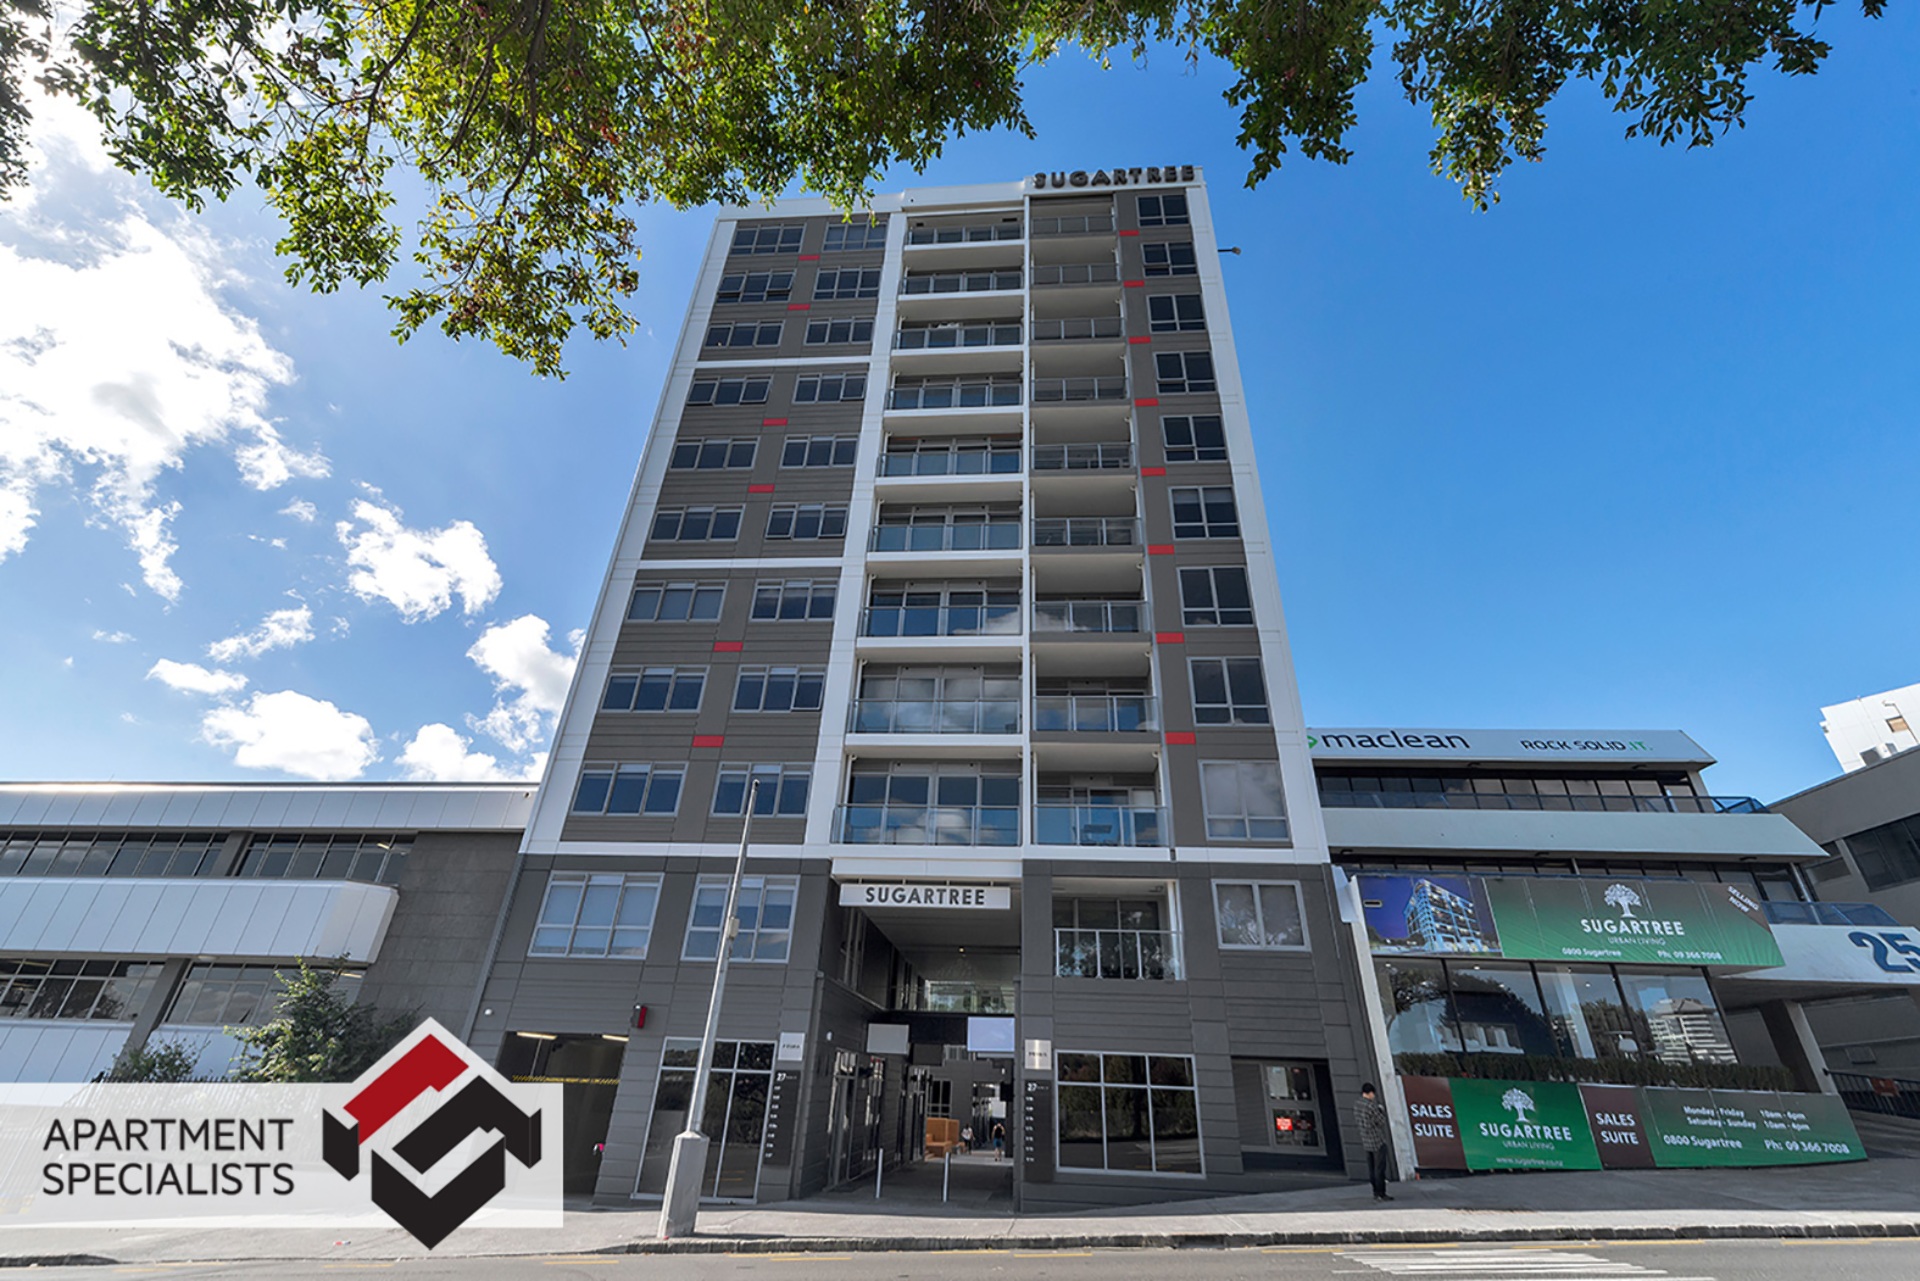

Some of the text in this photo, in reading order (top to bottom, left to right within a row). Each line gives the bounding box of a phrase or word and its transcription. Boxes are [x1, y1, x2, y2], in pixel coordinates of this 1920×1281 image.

[1034, 165, 1195, 189] SUGARTREE
[1321, 730, 1470, 749] maclean
[1520, 740, 1572, 751] ROCK
[1573, 740, 1627, 751] SOLID
[865, 886, 985, 906] SUGARTREE
[1580, 918, 1686, 936] SUGARTREE
[1608, 935, 1666, 946] URBAN LIVING
[1848, 931, 1920, 974] 25
[1410, 1103, 1453, 1119] SALES
[1683, 1105, 1715, 1117] Monday
[1719, 1107, 1745, 1118] Friday
[1595, 1112, 1636, 1127] SALES
[1687, 1116, 1722, 1128] Saturday
[1726, 1118, 1757, 1130] Sunday
[1414, 1123, 1455, 1138] SUITE
[1479, 1122, 1573, 1142] SUGARTREE
[1600, 1130, 1639, 1145] SUITE
[1502, 1140, 1555, 1151] URBAN LIVING
[1663, 1134, 1743, 1149] 0800 Sugartree
[1785, 1140, 1800, 1151] 09
[1801, 1141, 1822, 1152] 366
[1822, 1142, 1850, 1154] 7008
